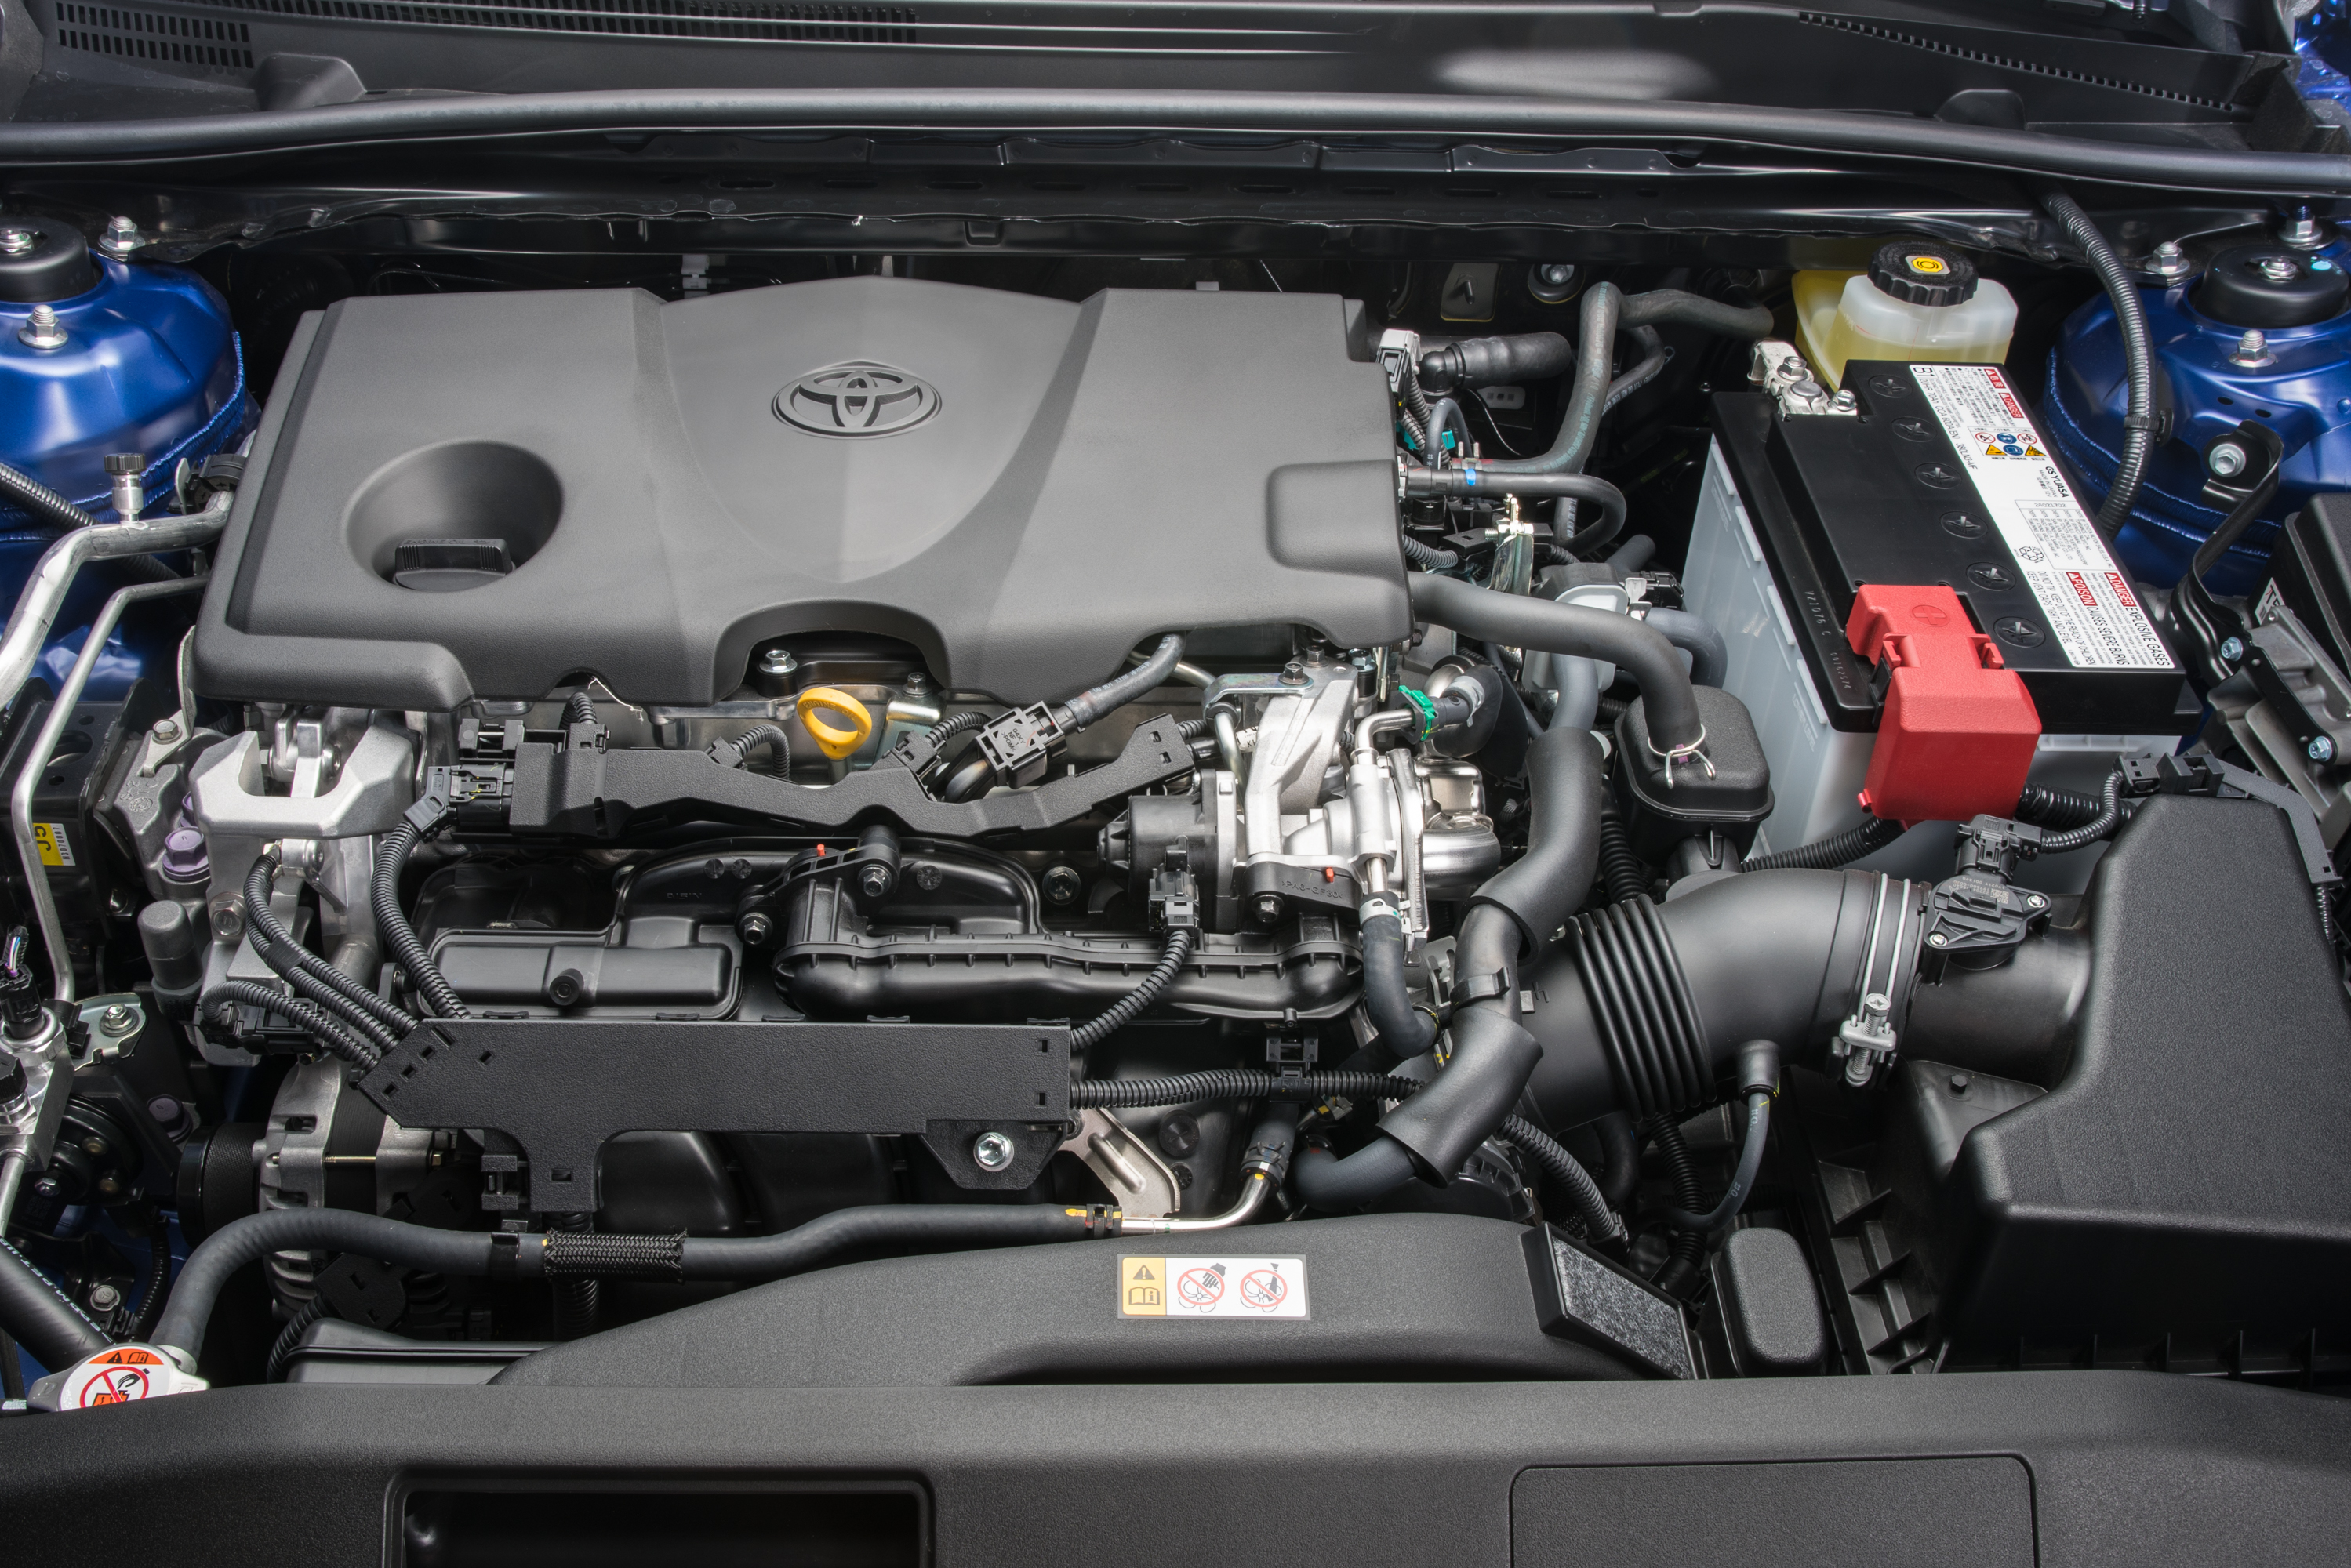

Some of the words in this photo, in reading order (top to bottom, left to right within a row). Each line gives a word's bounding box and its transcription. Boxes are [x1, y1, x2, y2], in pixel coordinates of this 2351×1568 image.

[1911, 366, 1936, 377] B1
[2002, 397, 2022, 418] DANGER
[2048, 474, 2071, 498] YUASA
[2025, 570, 2040, 581] KEEP
[2030, 582, 2046, 593] VENT
[2069, 579, 2096, 604] POISON
[2108, 579, 2135, 605] DANGER
[2037, 593, 2053, 605] CAPS
[2084, 606, 2109, 626] CAUSES
[2057, 630, 2074, 644] LEVEL
[2096, 626, 2120, 646] SEVERE
[2123, 607, 2157, 641] EXPLOSIVE
[2145, 643, 2172, 666] GASES
[2108, 648, 2131, 665] BURNS
[803, 701, 837, 710] ENGINE
[841, 709, 858, 721] OIL
